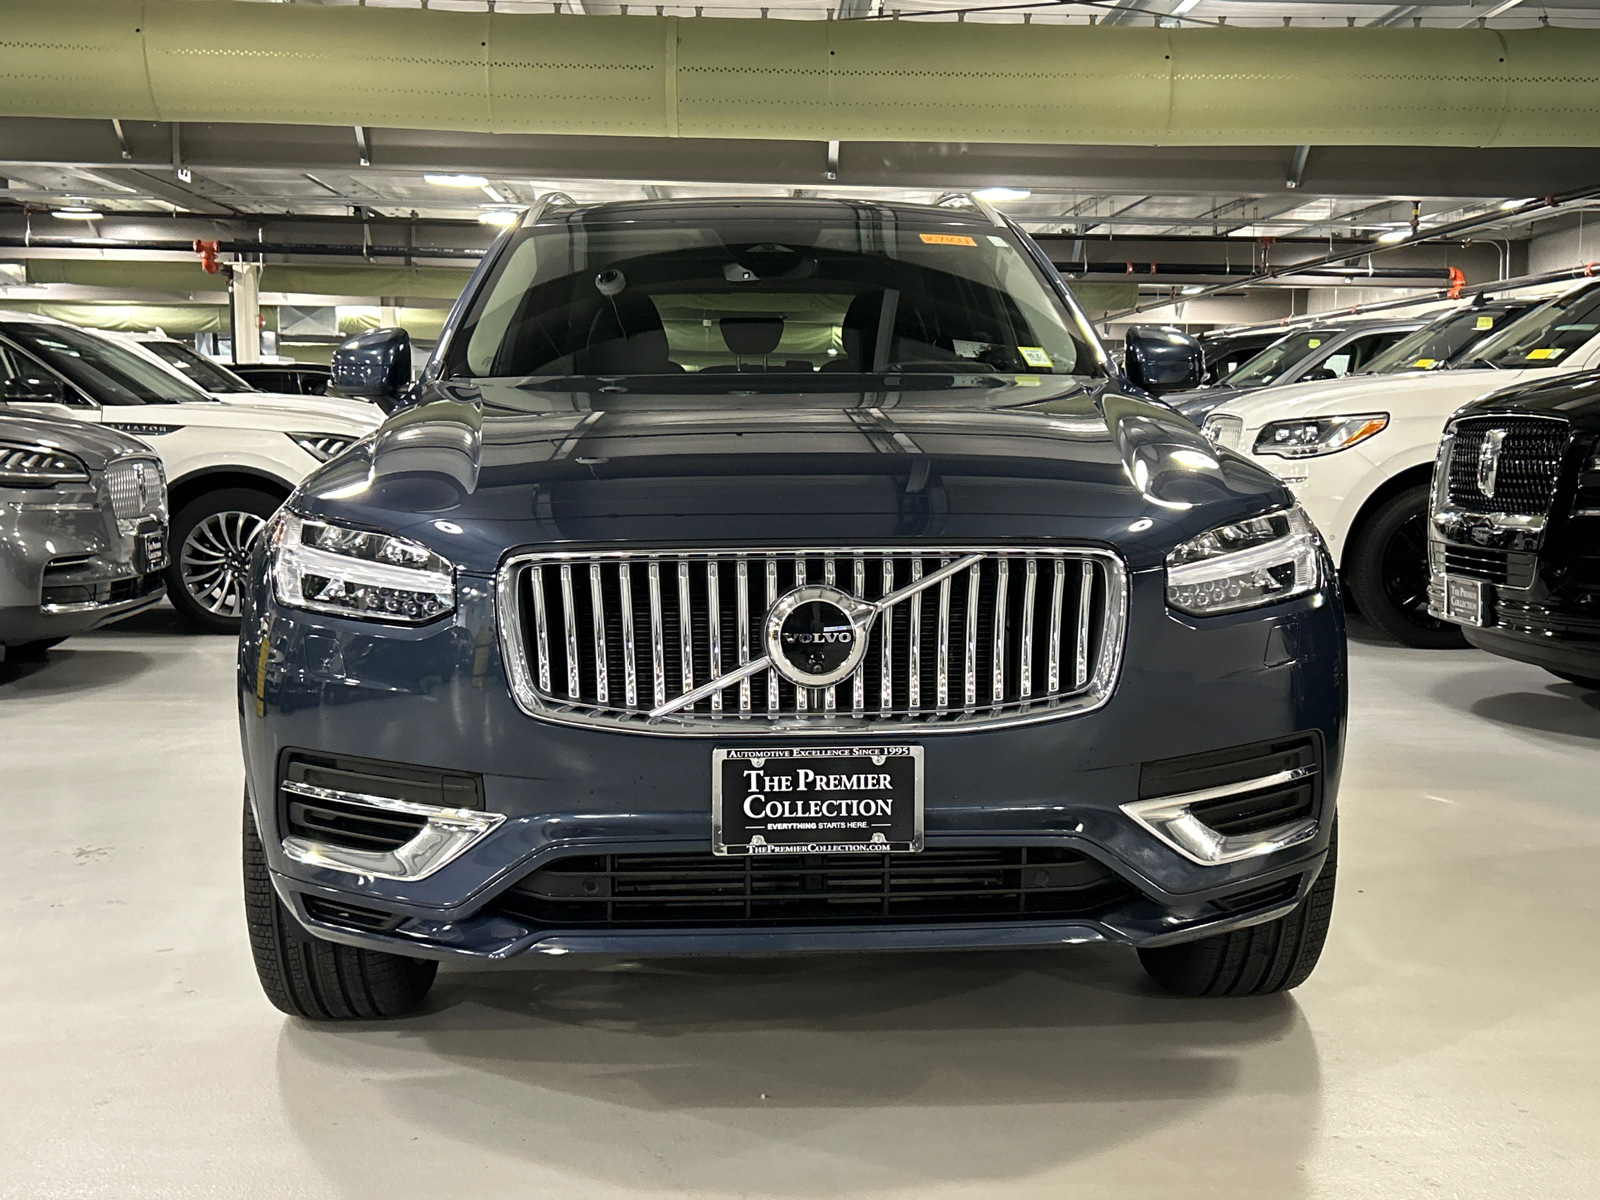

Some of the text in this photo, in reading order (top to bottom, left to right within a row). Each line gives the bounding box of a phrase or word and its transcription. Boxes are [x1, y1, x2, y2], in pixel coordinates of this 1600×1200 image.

[110, 424, 167, 432] AVIATOR
[783, 632, 852, 643] VOLVO
[883, 747, 909, 755] 1995
[743, 769, 893, 792] THE PREMIER
[743, 794, 893, 818] COLLECTION
